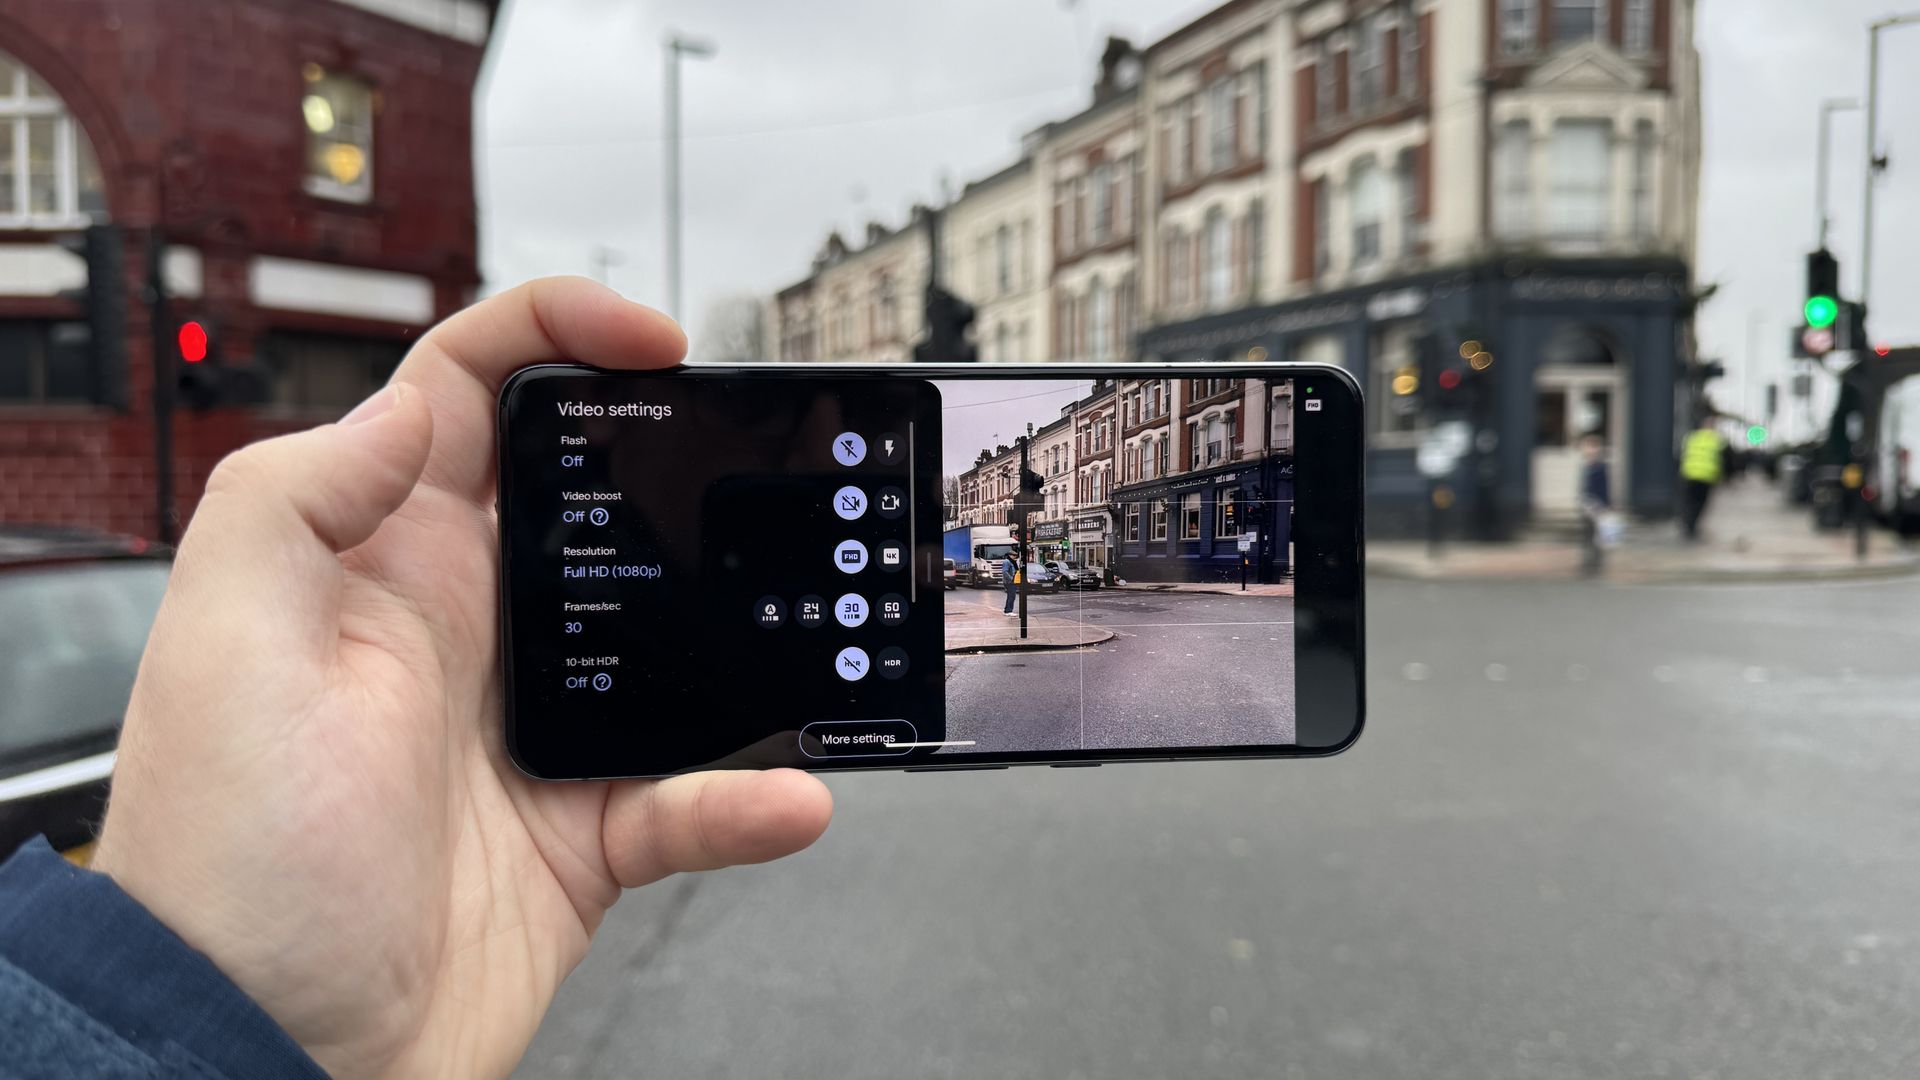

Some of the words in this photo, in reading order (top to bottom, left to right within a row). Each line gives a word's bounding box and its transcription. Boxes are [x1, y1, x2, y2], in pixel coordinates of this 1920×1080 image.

[557, 401, 604, 417] Video
[608, 401, 673, 420] settings
[561, 435, 587, 445] Flash
[561, 455, 584, 467] Off
[562, 491, 591, 501] Video
[593, 491, 622, 501] boost
[563, 511, 585, 522] Off
[563, 546, 616, 556] Resolution
[564, 566, 586, 578] Full
[589, 566, 609, 577] HD
[612, 563, 662, 579] (1080p)
[564, 602, 622, 612] Frames/sec
[804, 603, 819, 613] 24
[844, 603, 860, 613] 30
[884, 602, 900, 612] 60
[565, 621, 582, 633] 30
[566, 657, 595, 667] 10-bit
[597, 656, 619, 665] HDR
[566, 676, 588, 688] Off
[822, 734, 850, 744] More
[852, 733, 897, 747] settings
